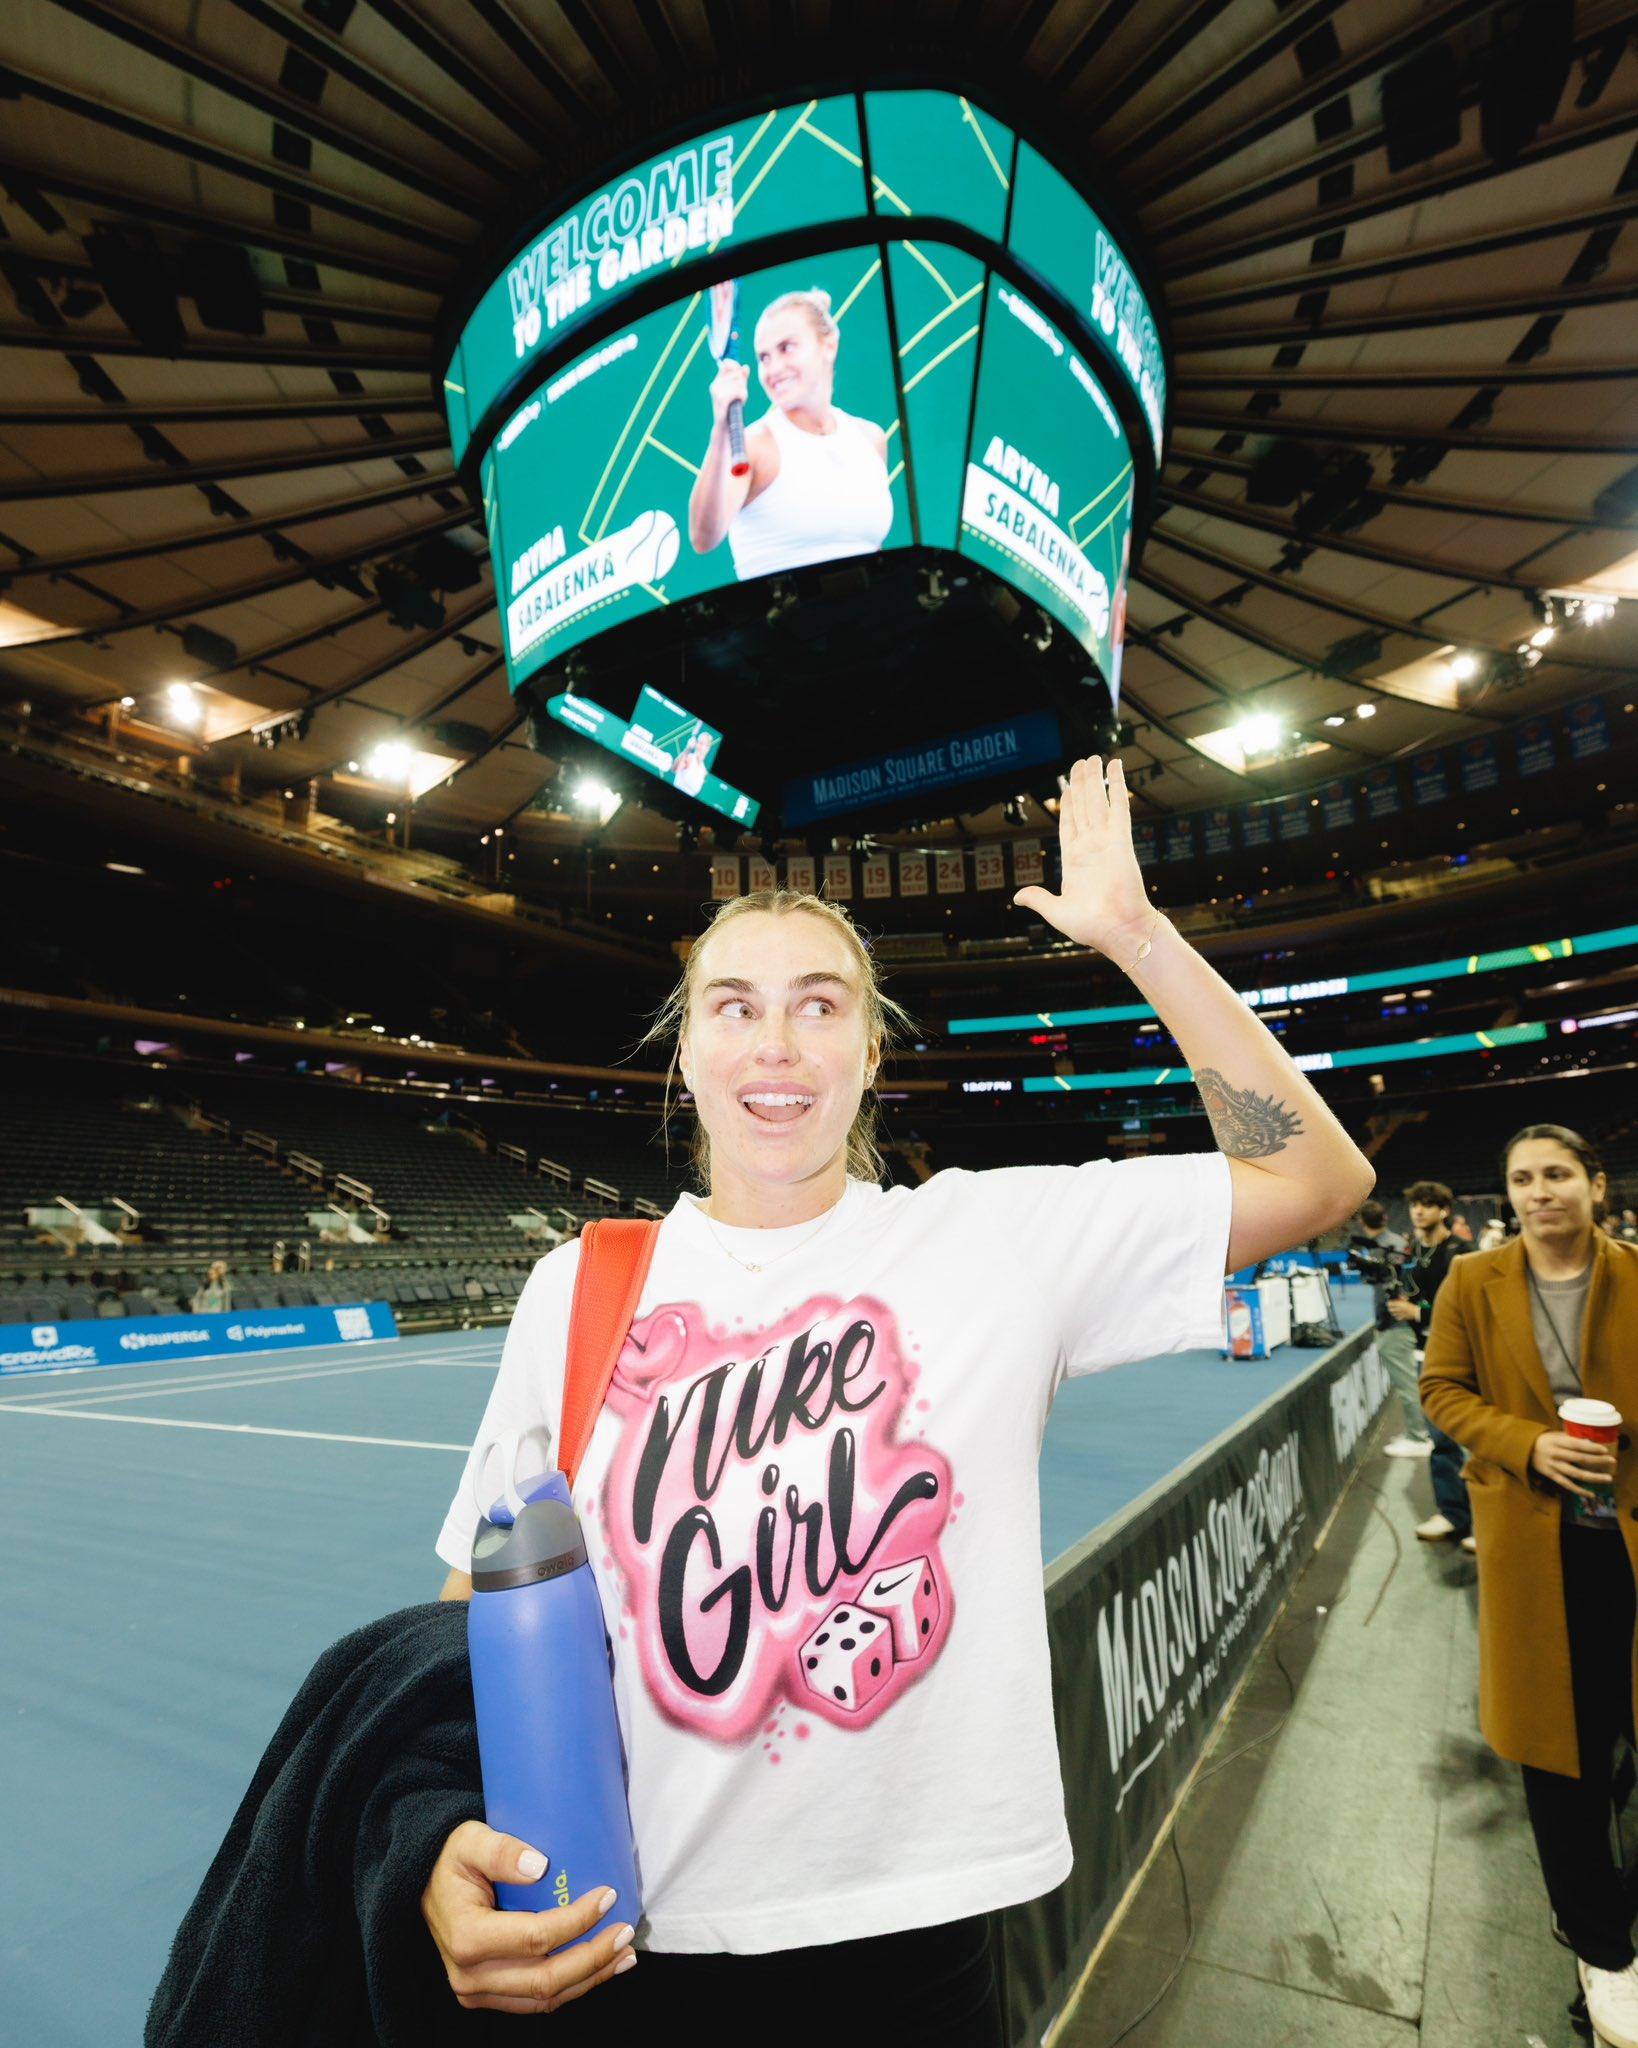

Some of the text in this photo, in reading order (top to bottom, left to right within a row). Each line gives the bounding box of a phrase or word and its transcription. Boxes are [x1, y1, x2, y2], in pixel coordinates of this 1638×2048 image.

[507, 135, 733, 322] WELCOME
[513, 196, 734, 358] TO THE GARDEN
[1091, 283, 1116, 336] TO
[983, 435, 1060, 518] ARYNA
[985, 493, 1084, 591] SABALENKA
[518, 556, 615, 634] SABALENKA
[813, 766, 882, 804] MADISON
[885, 748, 946, 785] SQUARE
[950, 729, 1018, 767] GARDEN
[939, 862, 961, 879] 24
[979, 857, 1000, 875] 33
[1014, 853, 1040, 870] 613
[717, 869, 735, 886] 10
[754, 870, 772, 886] 12
[791, 870, 810, 886] 15
[867, 867, 885, 884] 19
[902, 864, 924, 881] 22
[1288, 978, 1348, 1001] GARDEN
[146, 1329, 210, 1347] SUPERGA
[245, 1323, 305, 1338] Polymarket
[659, 1427, 938, 1696] Girl
[1097, 1528, 1215, 1775] MADISON
